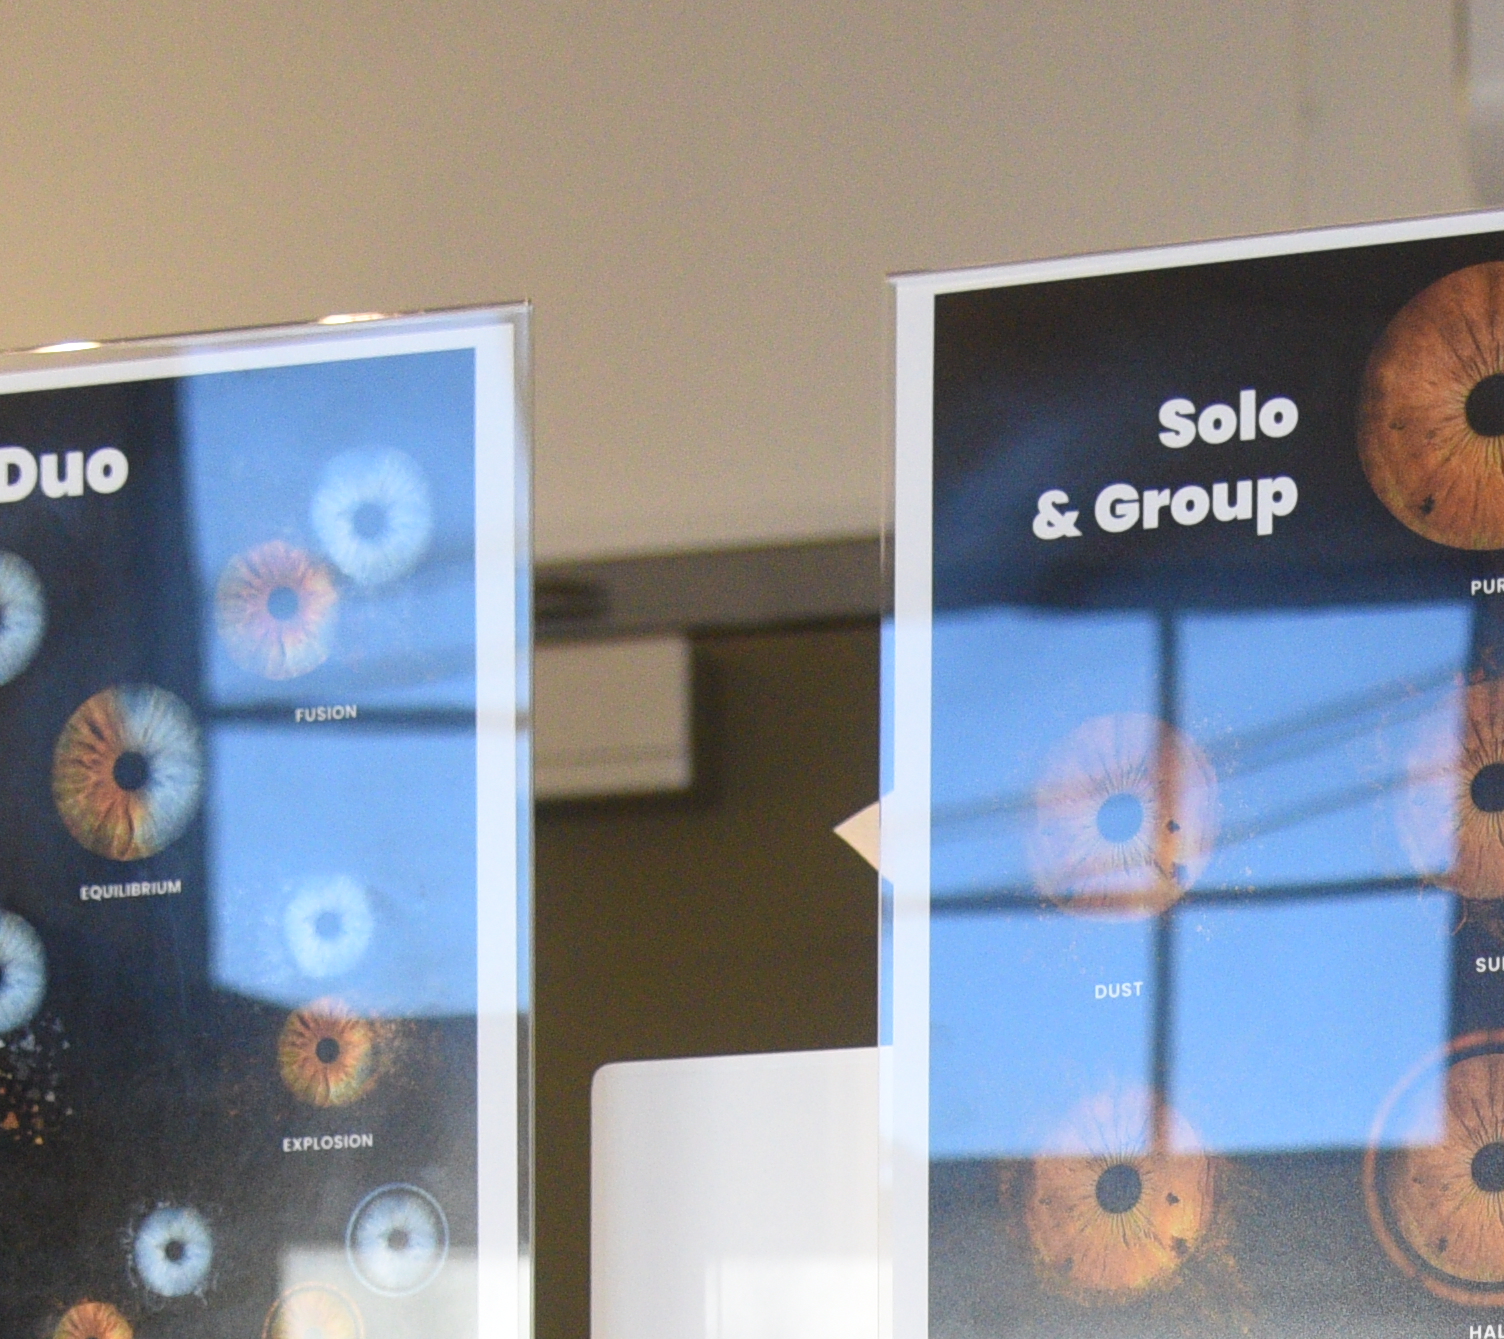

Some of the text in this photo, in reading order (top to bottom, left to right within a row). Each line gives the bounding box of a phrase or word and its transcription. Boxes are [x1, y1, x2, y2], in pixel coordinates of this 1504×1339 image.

[1157, 388, 1300, 450] Solo
[1031, 475, 1300, 541] & Group
[294, 704, 359, 723] FUSION
[79, 878, 183, 902] EQUILIBRIUM
[1093, 979, 1145, 1001] DUST
[281, 1132, 375, 1154] EXPLOSION
